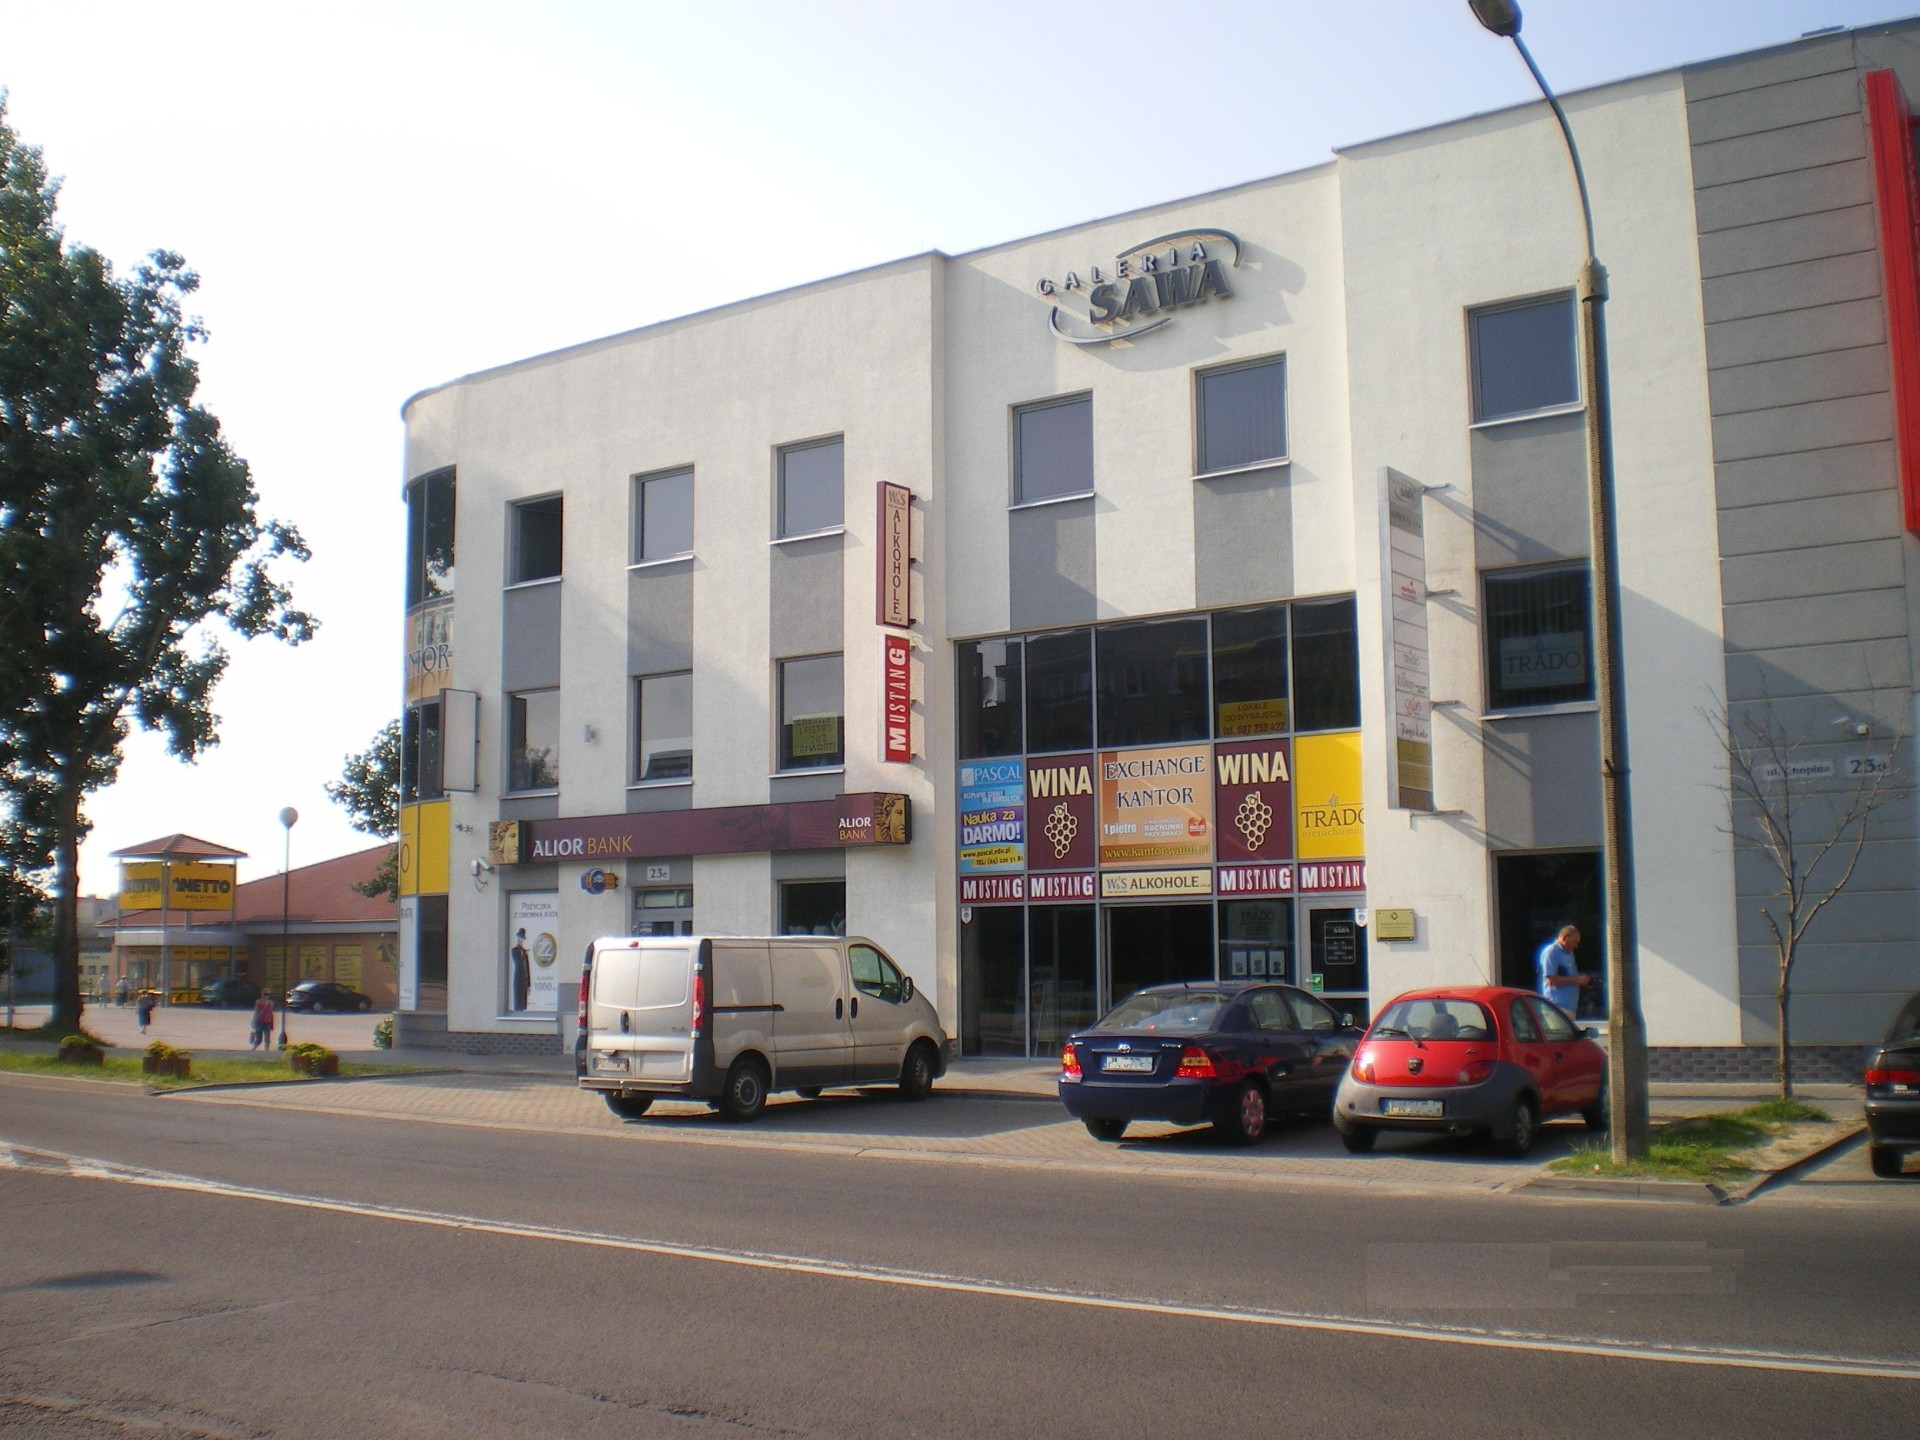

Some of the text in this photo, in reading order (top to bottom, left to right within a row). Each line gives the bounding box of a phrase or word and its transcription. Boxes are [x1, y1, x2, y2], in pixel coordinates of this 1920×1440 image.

[1036, 241, 1206, 296] GALERIA
[1089, 258, 1233, 325] SAWA
[892, 508, 902, 615] ALKOHOLE
[1504, 650, 1581, 674] TRADO
[888, 647, 907, 752] MUSTANG
[974, 765, 1023, 781] PASCAL
[1104, 755, 1206, 781] EXCHANGE
[1217, 750, 1290, 785] WINA
[1029, 765, 1094, 798] WINA
[1116, 786, 1195, 809] KANTOR
[838, 816, 872, 828] ALIOR
[963, 810, 1016, 826] Nauka za
[1143, 823, 1184, 832] RACHUNKI
[839, 829, 867, 841] BANK
[963, 822, 1021, 845] DARMO!
[532, 835, 633, 857] ALIOR BANK
[963, 845, 1011, 858] www.pascal.edu.pl
[1104, 842, 1211, 858] www.kantor-walut.pl
[175, 878, 231, 894] NETTO
[1030, 874, 1094, 898] MUSTANG
[1130, 875, 1200, 889] ALKOHOLE
[1220, 868, 1291, 892] MUSTANG
[1301, 865, 1367, 889] MUSTAN
[963, 878, 1023, 900] MUSTANG
[534, 982, 553, 992] 1000
